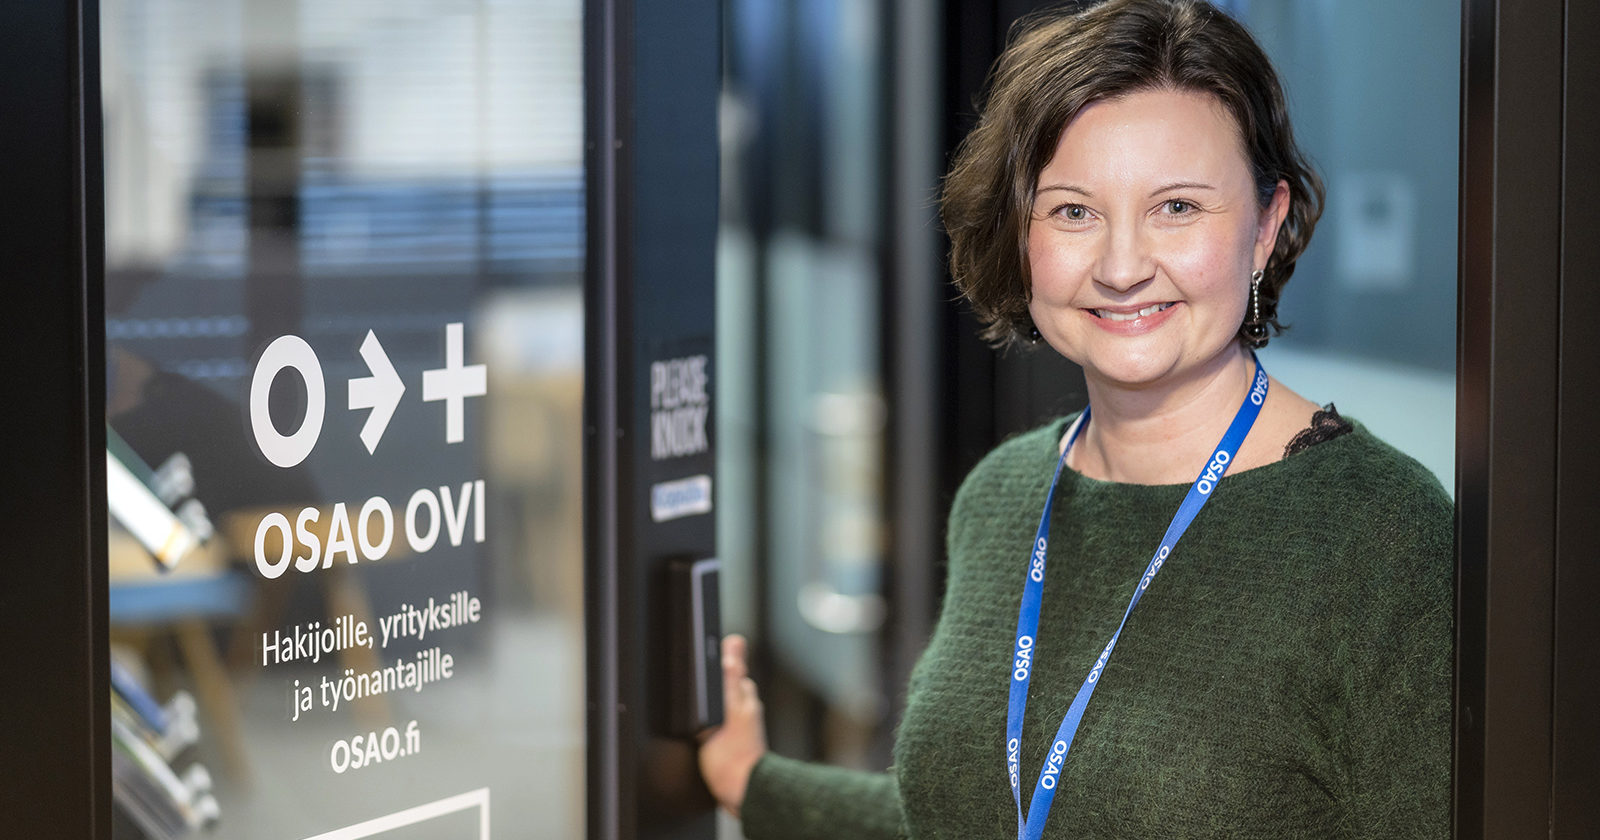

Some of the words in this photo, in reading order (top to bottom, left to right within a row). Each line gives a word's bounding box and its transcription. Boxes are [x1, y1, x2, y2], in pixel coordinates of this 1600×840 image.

[1250, 369, 1268, 406] OSAO
[1197, 450, 1230, 495] OSAO
[254, 496, 394, 579] OSAO
[404, 480, 486, 553] OVI
[1030, 537, 1047, 582] OSAO
[1141, 545, 1170, 590] OSAO
[262, 614, 374, 666] Hakijoille,
[379, 590, 481, 648] yrityksille
[1014, 635, 1033, 681] OSAO
[1087, 638, 1115, 684] OSAO
[292, 679, 313, 722] ja
[320, 646, 454, 712] työnantajille
[330, 720, 420, 774] OSAO.fi
[1008, 738, 1019, 788] OSAO
[1041, 740, 1068, 790] OSAO
